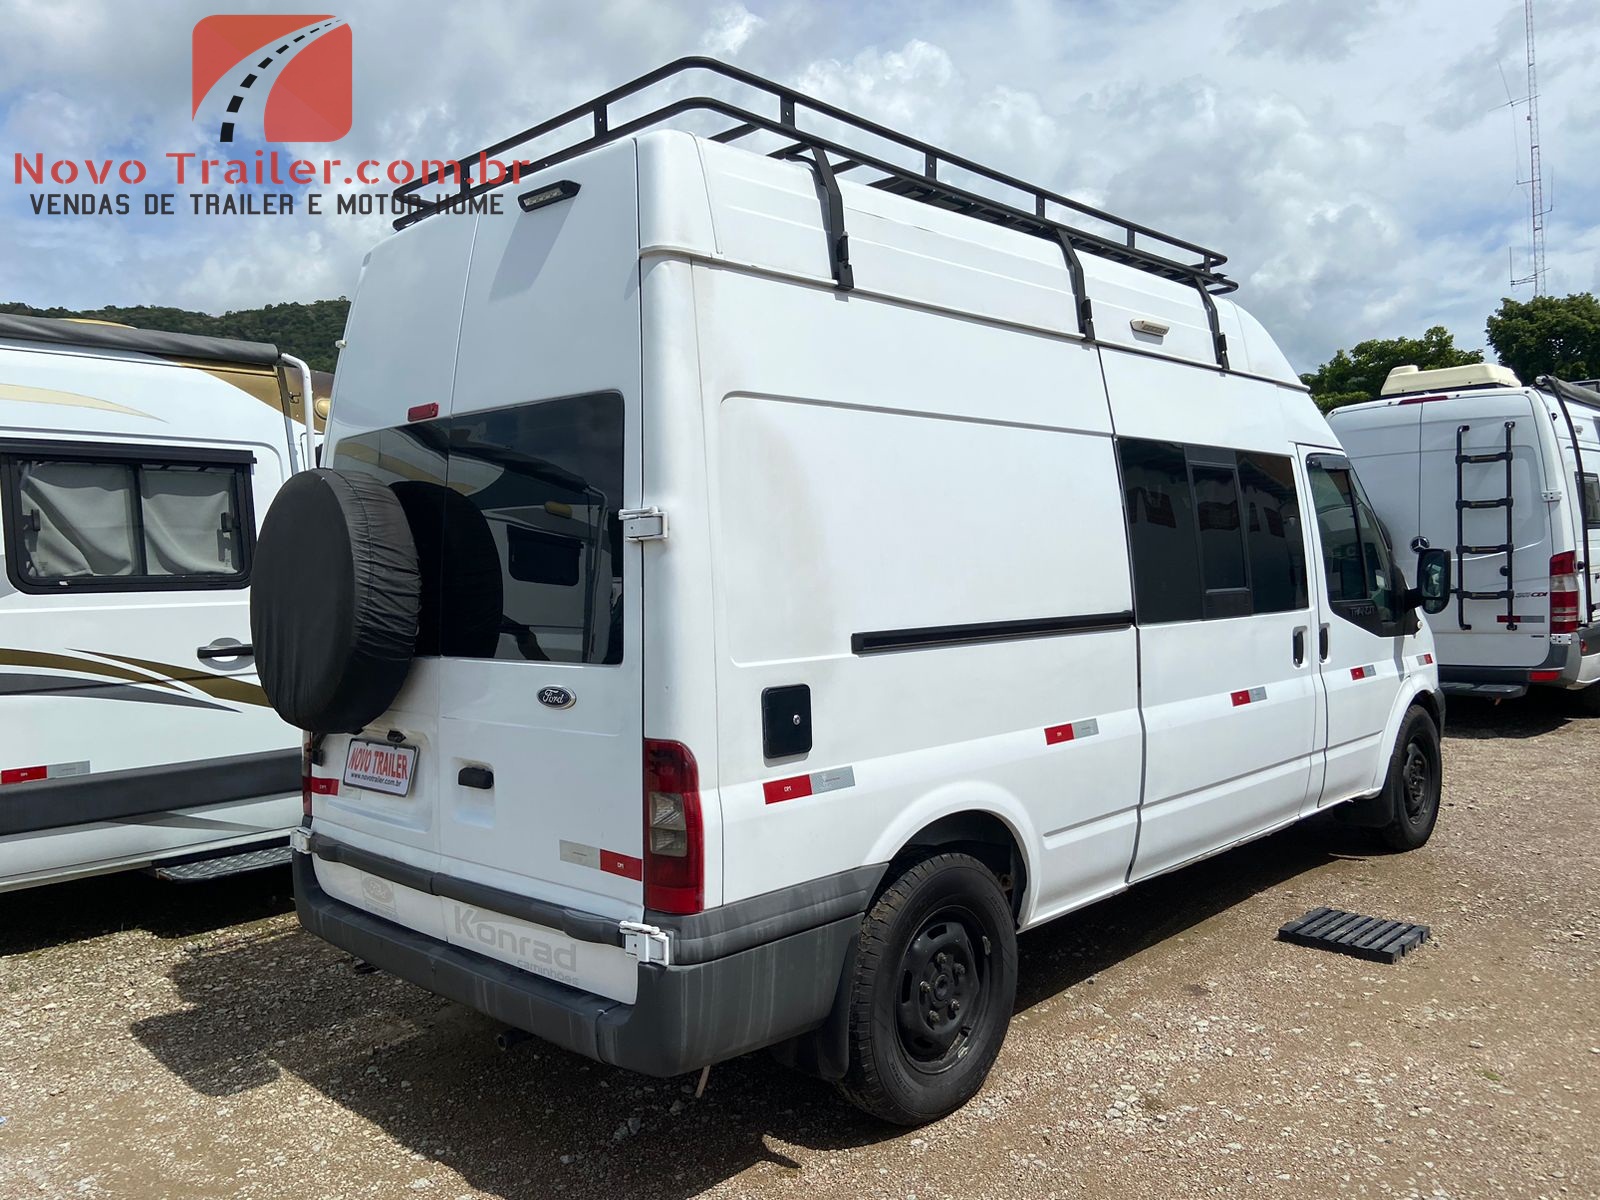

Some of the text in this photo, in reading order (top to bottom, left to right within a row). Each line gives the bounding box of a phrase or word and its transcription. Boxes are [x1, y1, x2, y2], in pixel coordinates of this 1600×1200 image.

[348, 747, 409, 780] NOVO TRAILER
[453, 904, 577, 973] Konrad
